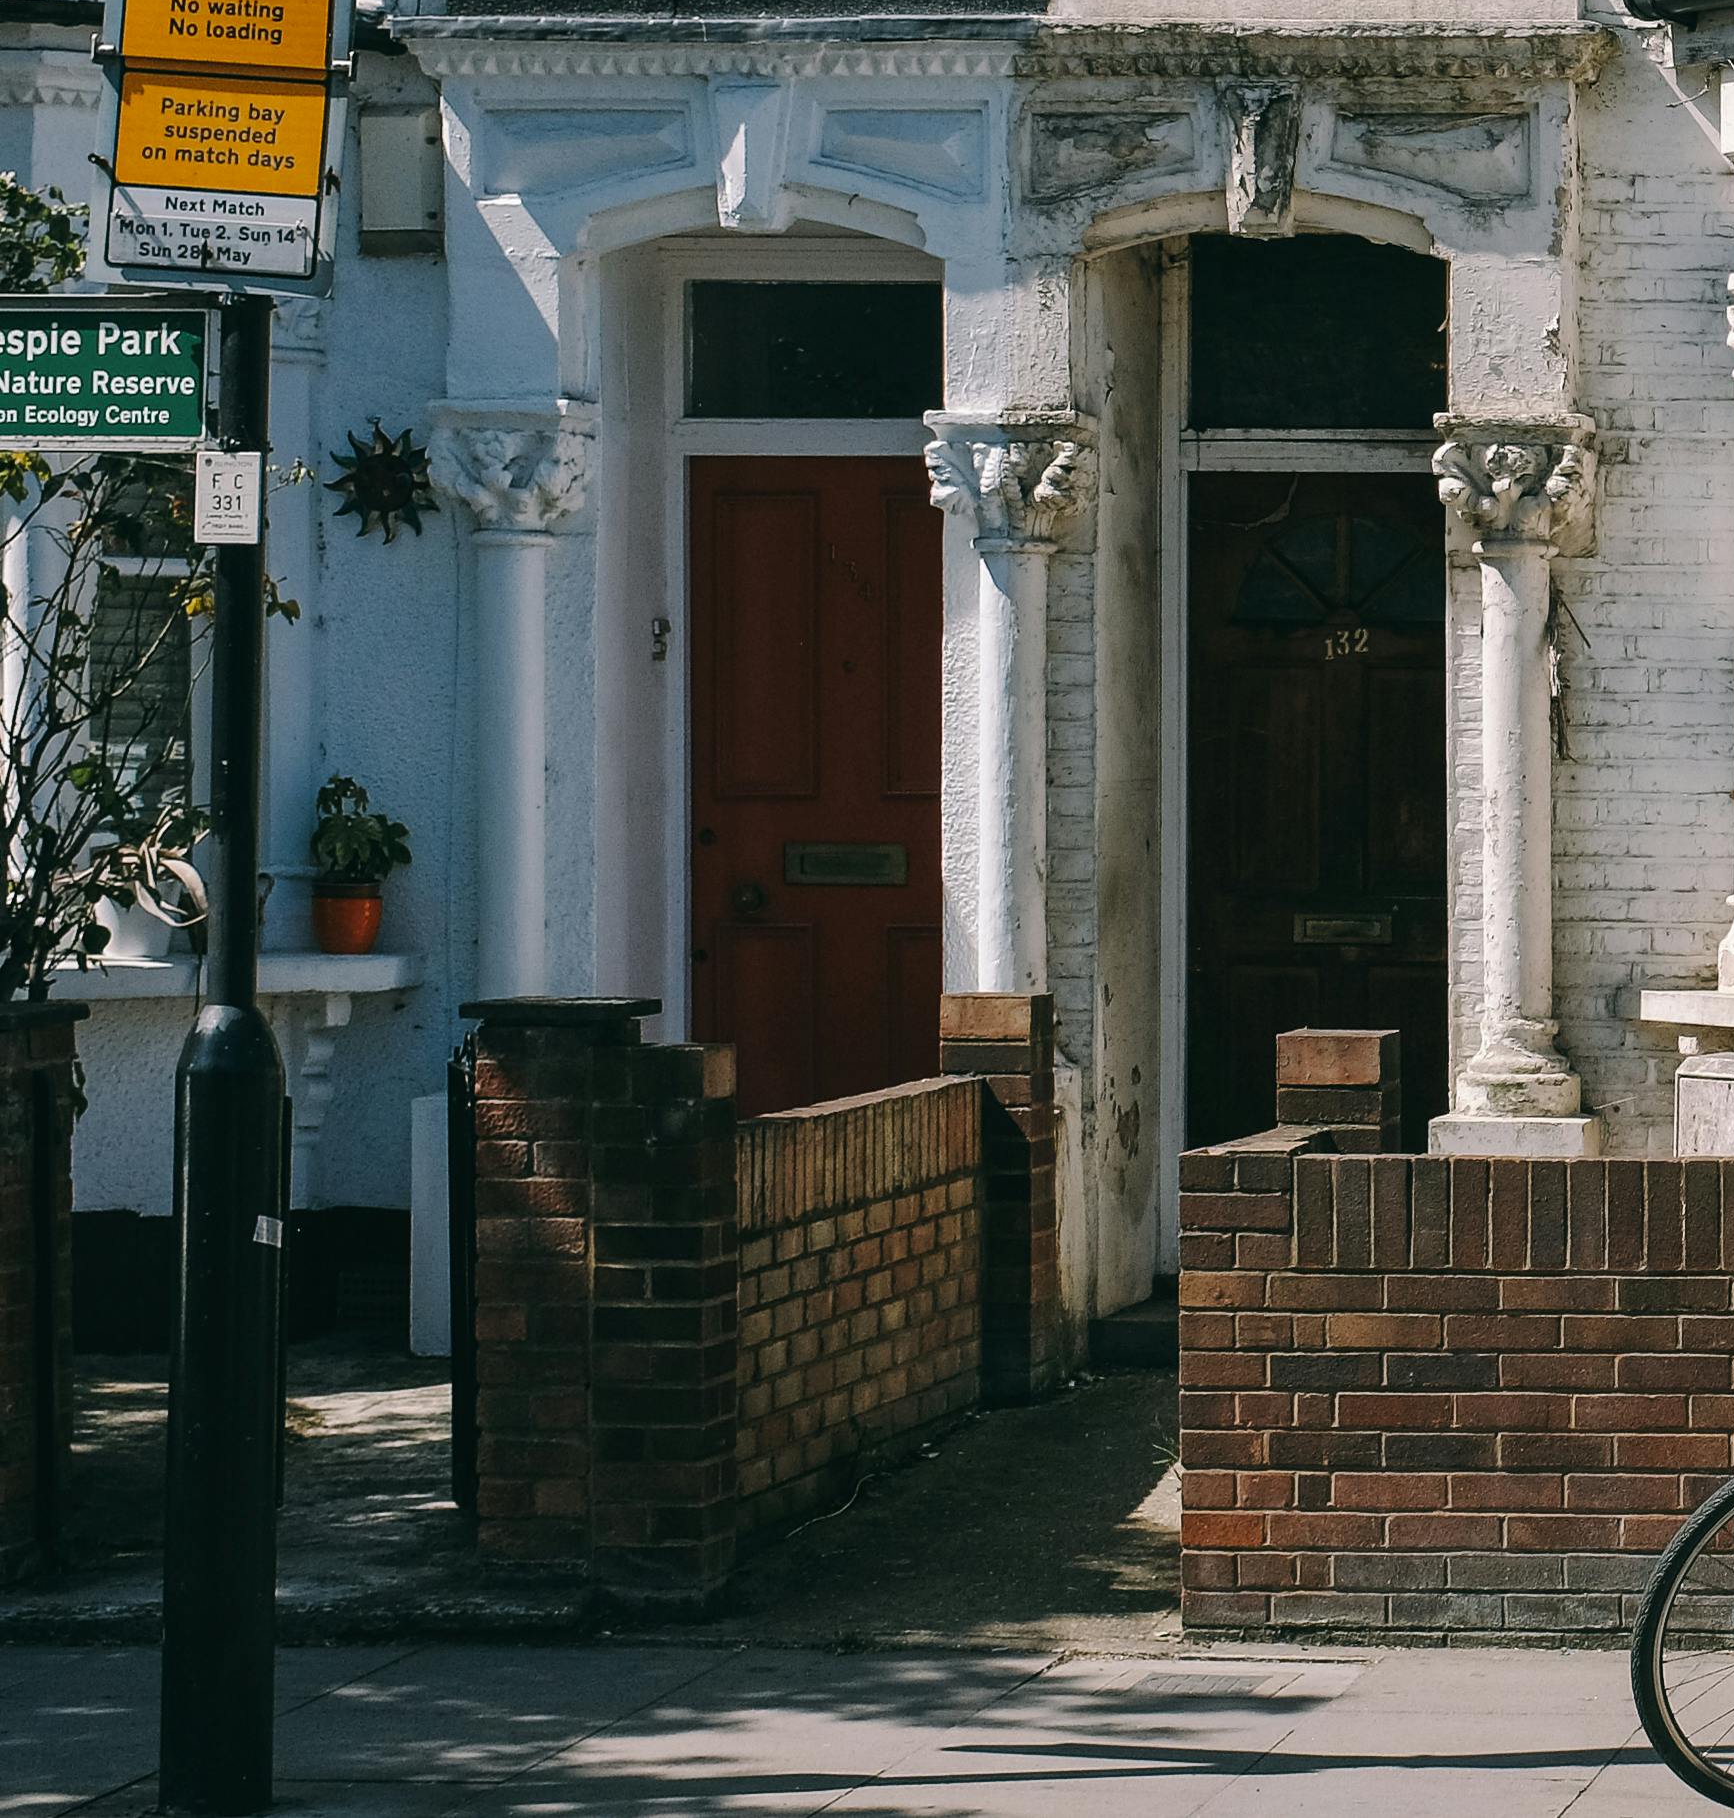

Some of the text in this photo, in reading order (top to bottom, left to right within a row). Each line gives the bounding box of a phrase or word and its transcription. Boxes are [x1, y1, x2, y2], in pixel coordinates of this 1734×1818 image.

[169, 18, 283, 45] No loading
[161, 97, 286, 124] Parking bay
[164, 124, 276, 145] suspended
[142, 145, 295, 171] on match days
[165, 195, 265, 217] Next Match
[119, 219, 155, 237] Mon
[179, 223, 211, 239] Tue
[238, 227, 271, 243] Sun
[138, 242, 172, 259] Sun
[216, 247, 252, 265] May
[98, 322, 182, 356] Park
[0, 369, 196, 396] Nature Reserve
[25, 405, 99, 427] Ecology
[105, 405, 170, 424] Centre
[212, 495, 241, 511] 331
[1323, 628, 1369, 661] 132
